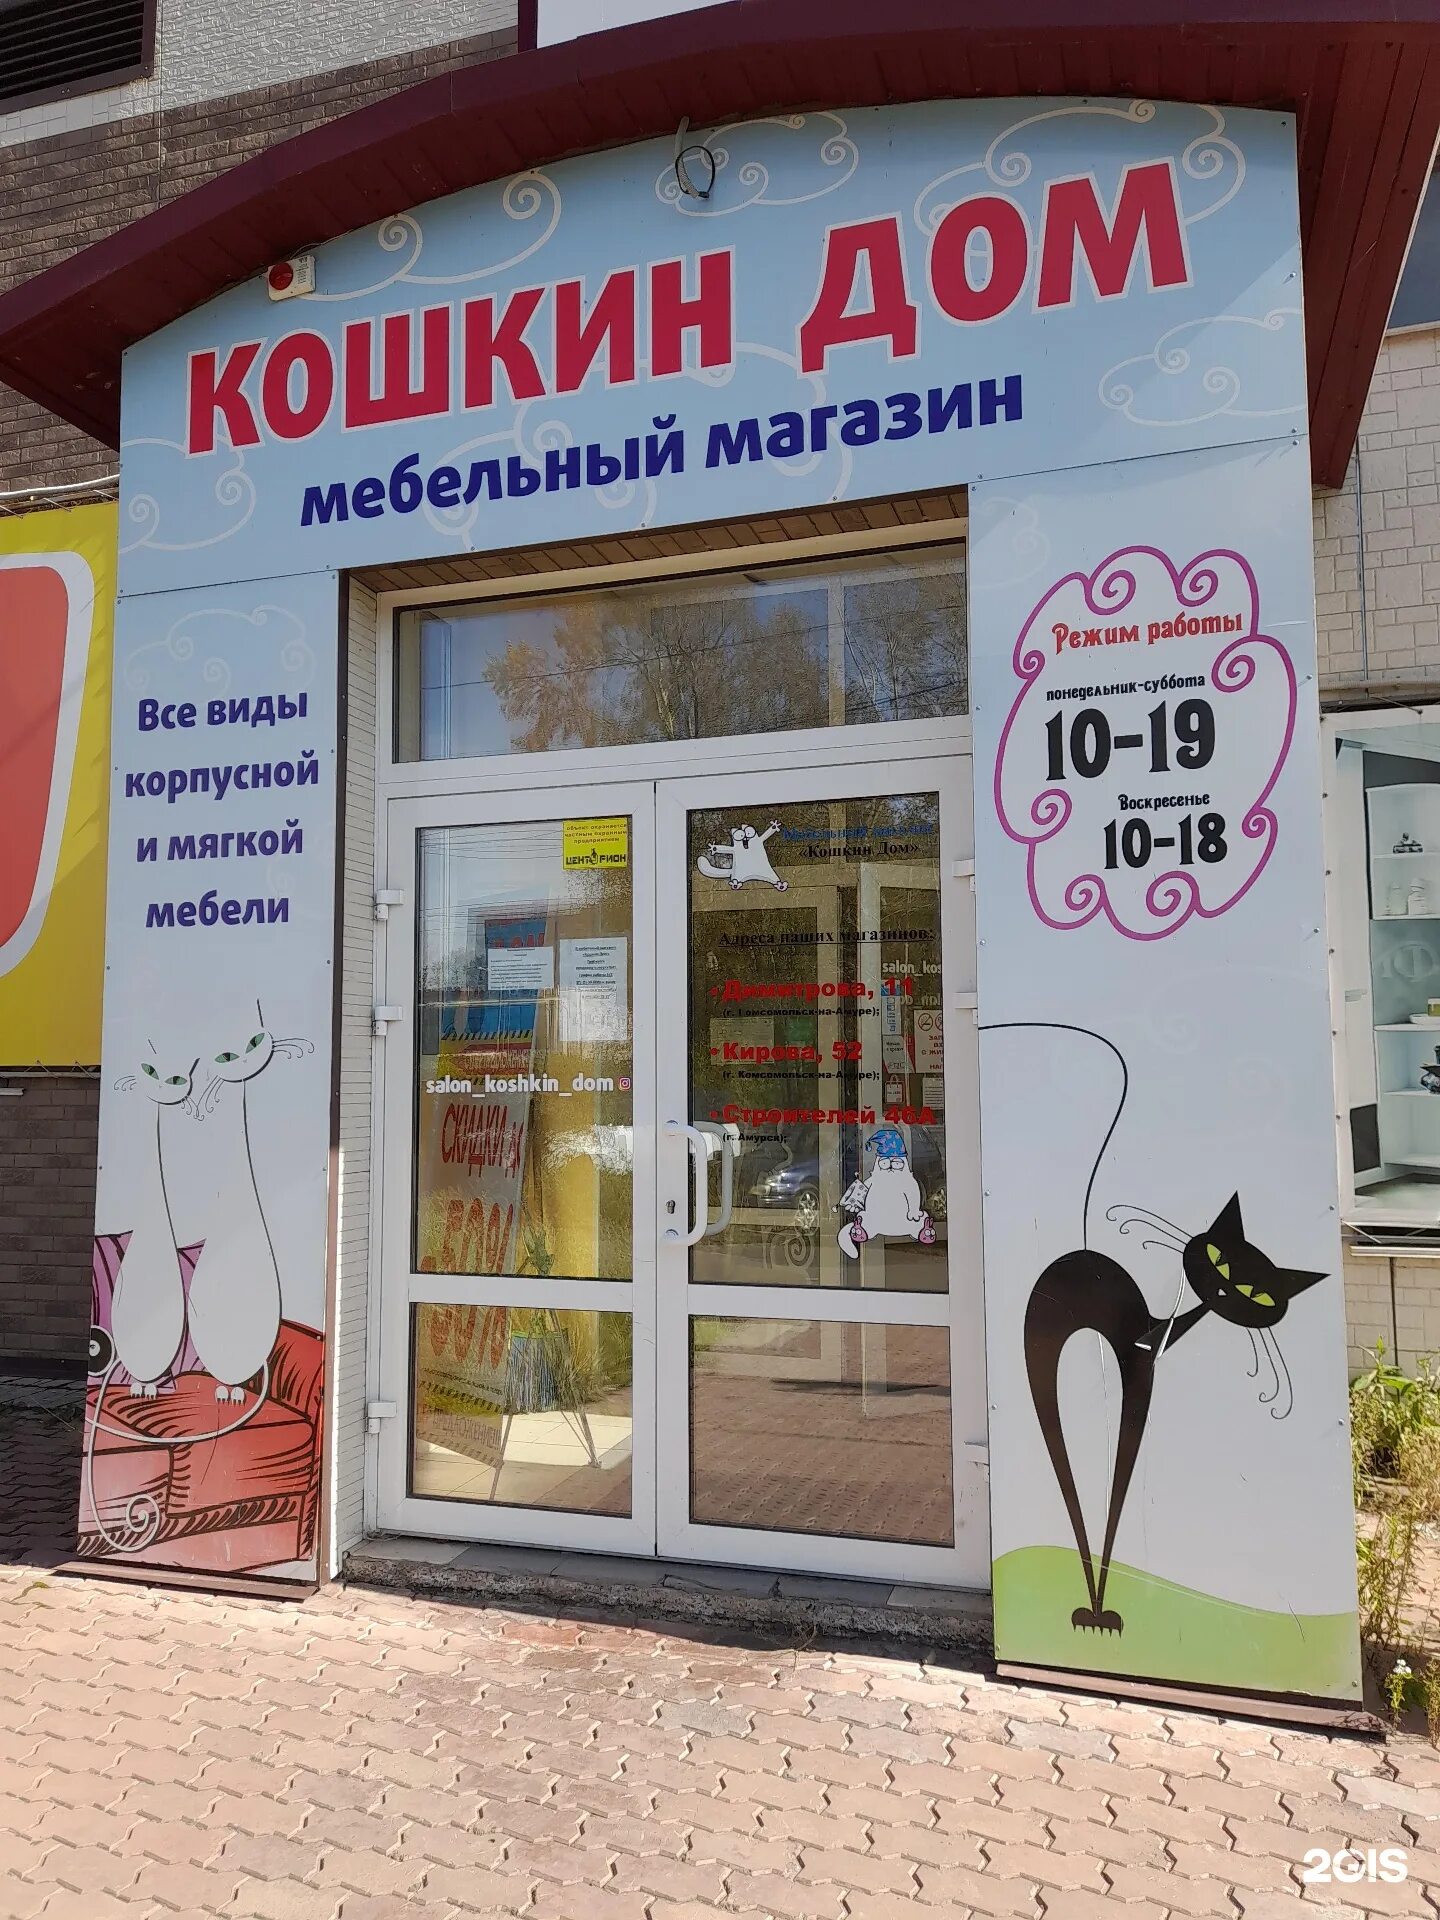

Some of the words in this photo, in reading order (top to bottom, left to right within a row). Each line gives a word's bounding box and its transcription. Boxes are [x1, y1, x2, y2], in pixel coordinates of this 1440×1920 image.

[187, 248, 734, 457] КОШКИН
[799, 161, 1189, 374] ДОМ
[300, 414, 685, 527] мебельный
[704, 374, 1023, 469] магазин
[1051, 622, 1140, 655] Режим
[1147, 611, 1244, 645] работы
[1046, 673, 1206, 701] понедельник-суббота
[138, 698, 197, 731] Все
[206, 692, 308, 728] виды
[1045, 698, 1216, 781] 10-19
[125, 749, 319, 803] корпусной
[1117, 793, 1210, 811] Воскресенье
[136, 837, 158, 862] и
[167, 818, 303, 861] мягкой
[877, 841, 919, 855] Дом»
[1103, 812, 1228, 870] 10-18
[145, 889, 289, 928] мебели
[719, 931, 775, 946] Адреса
[780, 930, 834, 944] наших
[840, 927, 935, 943] магазинов:
[722, 980, 874, 1003] Димитрова,
[884, 976, 914, 996] 11
[722, 1006, 736, 1017] (г.
[722, 1041, 823, 1064] Кирова,
[831, 1041, 863, 1060] 52
[425, 1073, 614, 1098] salon_koshkin_dom
[722, 1070, 735, 1080] (г.
[722, 1104, 876, 1127] Строителей
[884, 1104, 936, 1126] 46А
